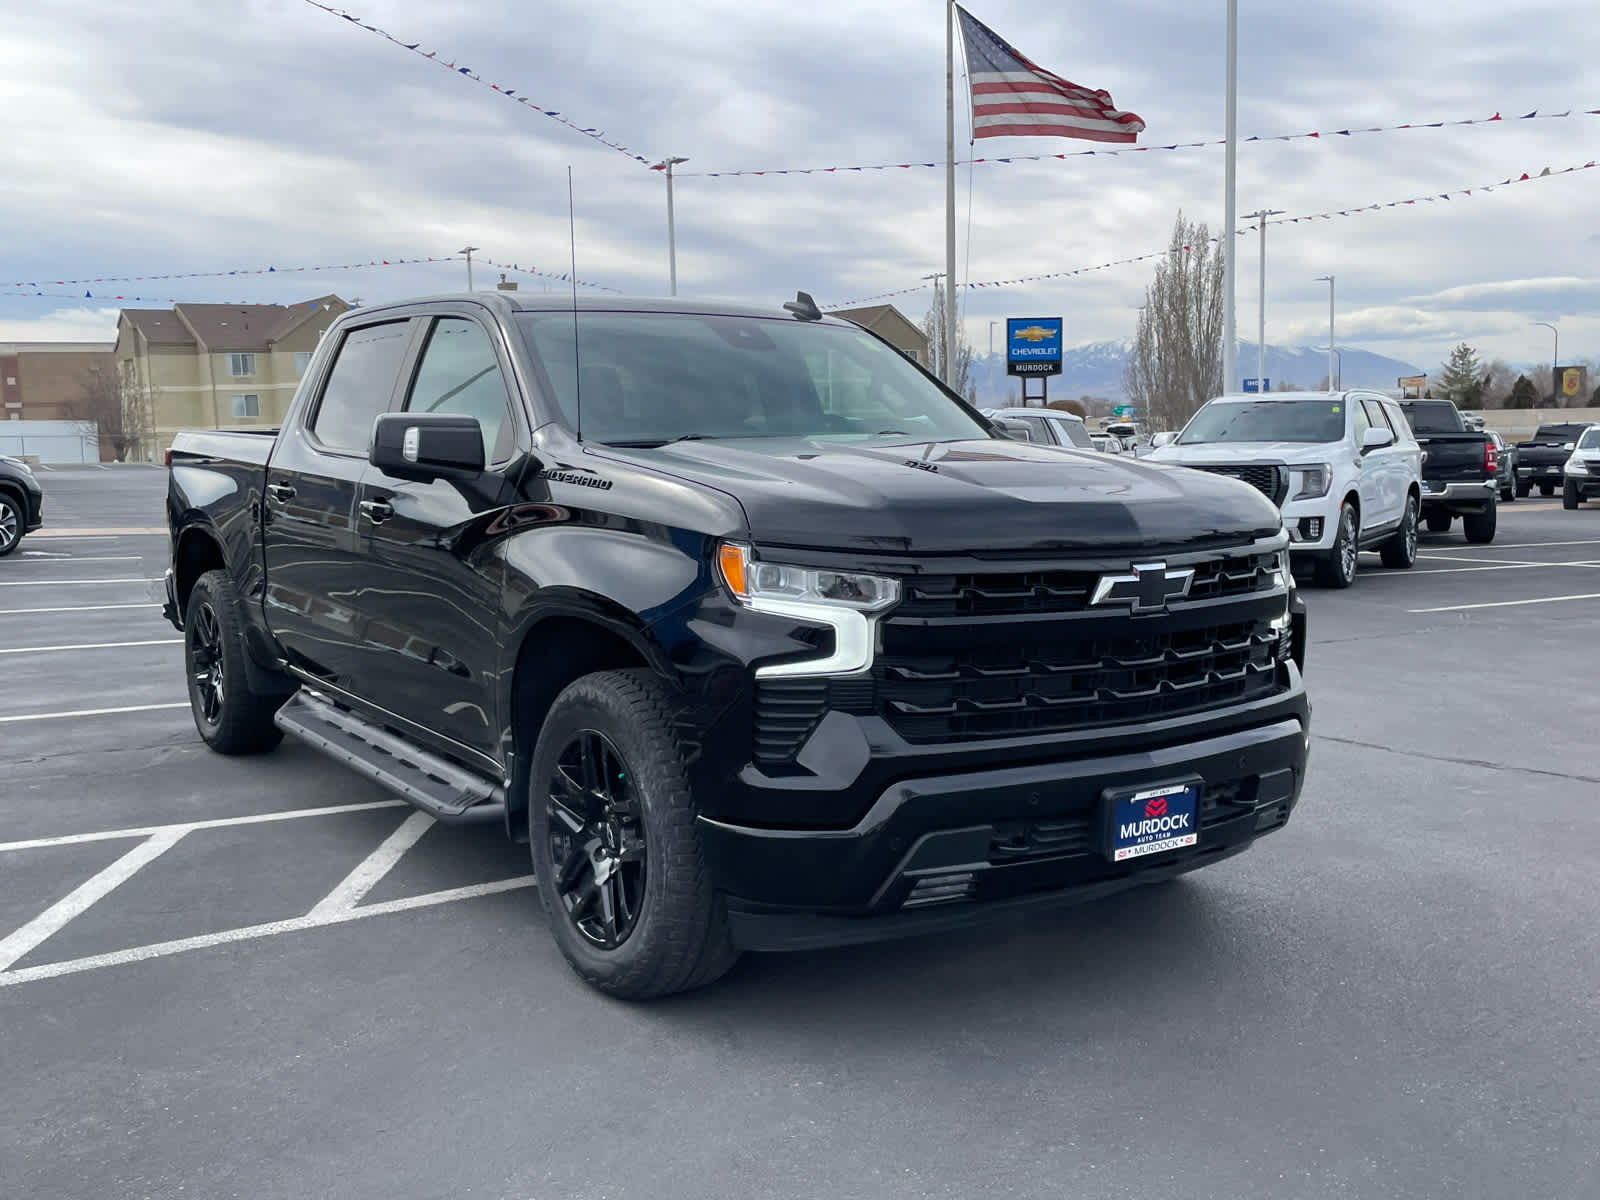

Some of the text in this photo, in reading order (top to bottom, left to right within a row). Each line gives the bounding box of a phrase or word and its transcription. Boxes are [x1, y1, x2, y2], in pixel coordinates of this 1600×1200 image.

[1011, 347, 1057, 356] CHEVROLET
[1120, 813, 1190, 839] MURDOCK
[1137, 832, 1171, 843] AUTO TEAM
[1134, 838, 1180, 855] MURDOCK
